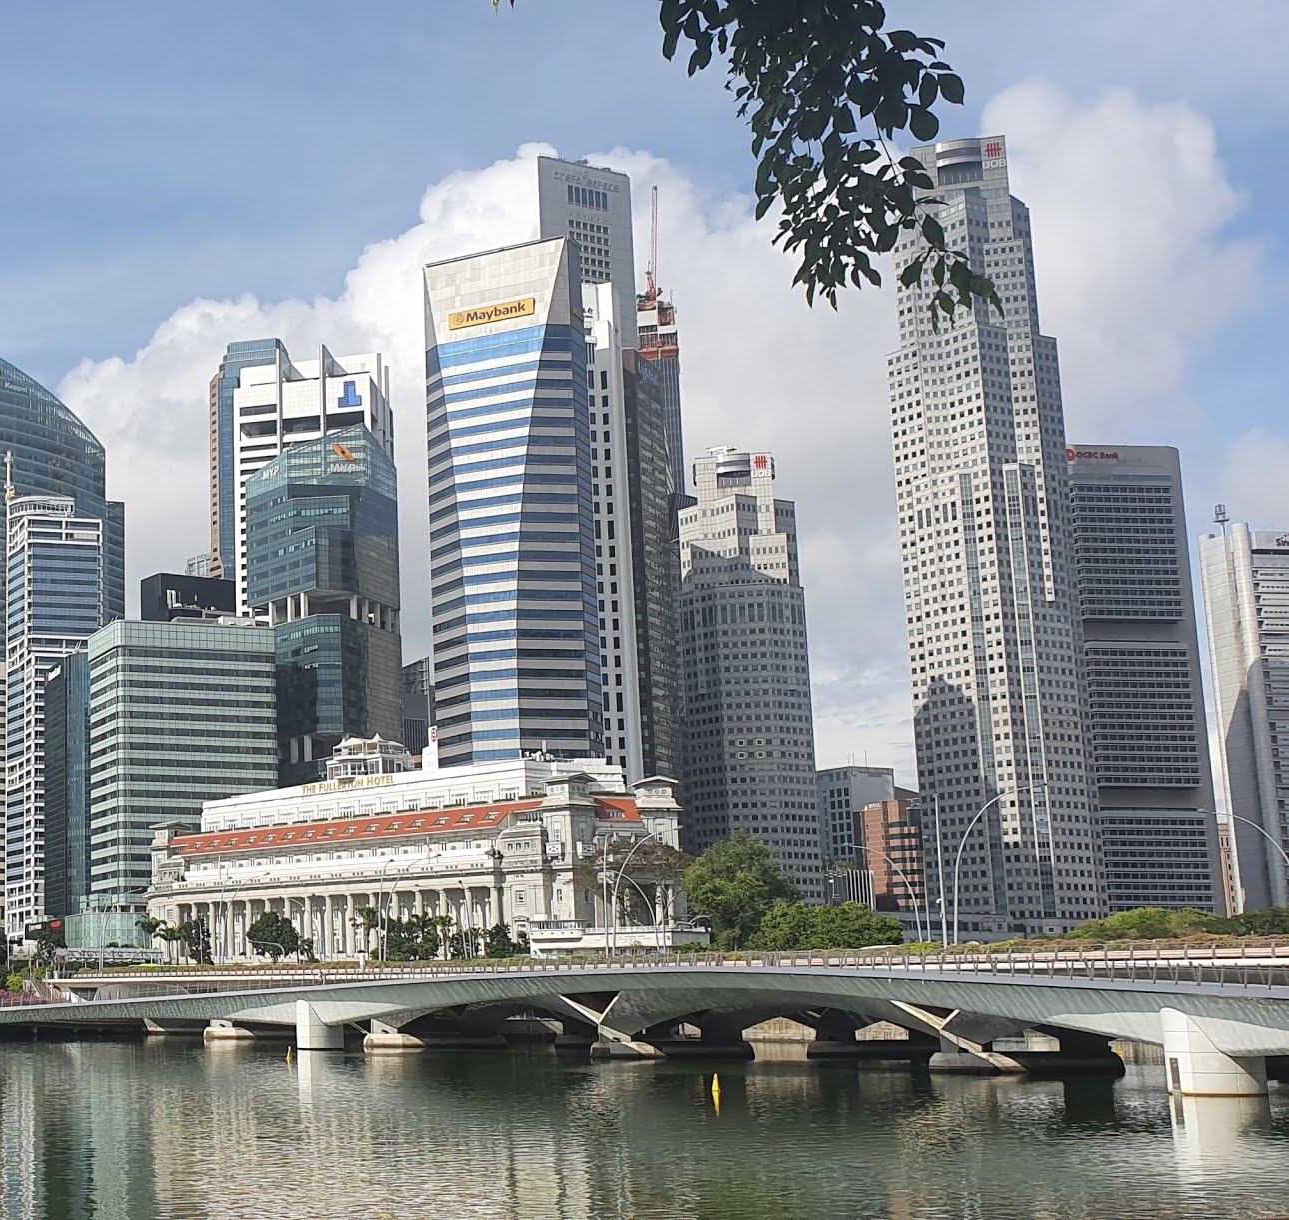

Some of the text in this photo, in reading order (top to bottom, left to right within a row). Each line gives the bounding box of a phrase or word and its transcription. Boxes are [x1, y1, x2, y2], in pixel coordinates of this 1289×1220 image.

[982, 158, 1007, 170] UOB
[466, 301, 526, 323] Maybank
[5, 381, 28, 393] Keppel
[1076, 451, 1120, 461] OCBC Bank
[263, 466, 280, 480] MYP
[751, 470, 772, 478] UOB
[302, 774, 395, 794] THE FULLERTON HOTEL
